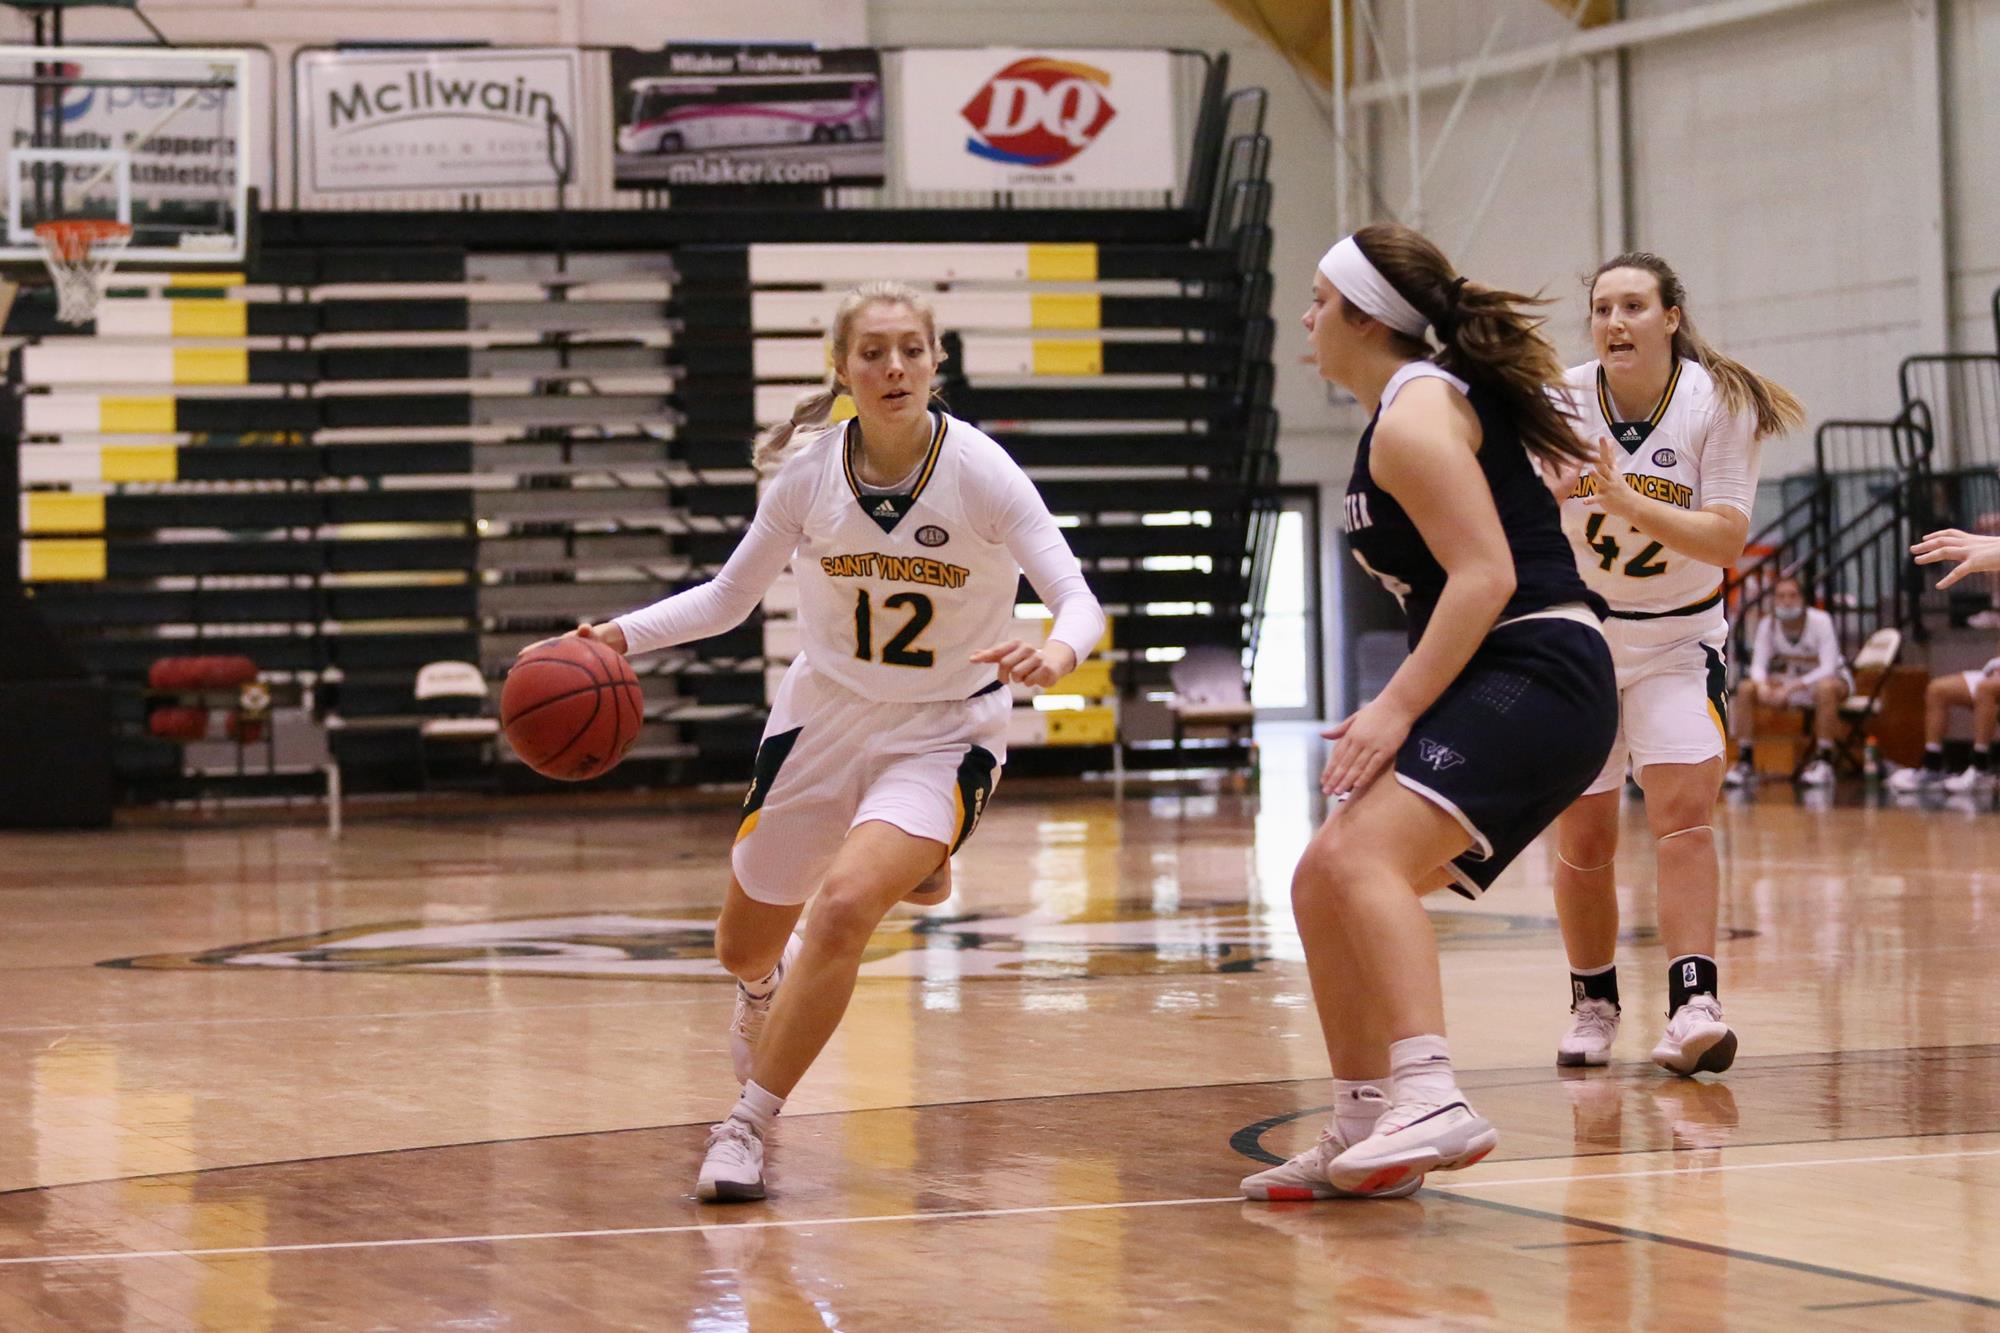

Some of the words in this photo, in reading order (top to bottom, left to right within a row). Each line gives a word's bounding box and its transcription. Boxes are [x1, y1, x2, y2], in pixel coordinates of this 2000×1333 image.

[328, 69, 552, 129] McIlwain
[982, 78, 1100, 147] DQ
[821, 552, 876, 577] SAINT
[876, 552, 969, 589] VINCENT
[1585, 512, 1668, 577] 42
[854, 587, 934, 668] 12
